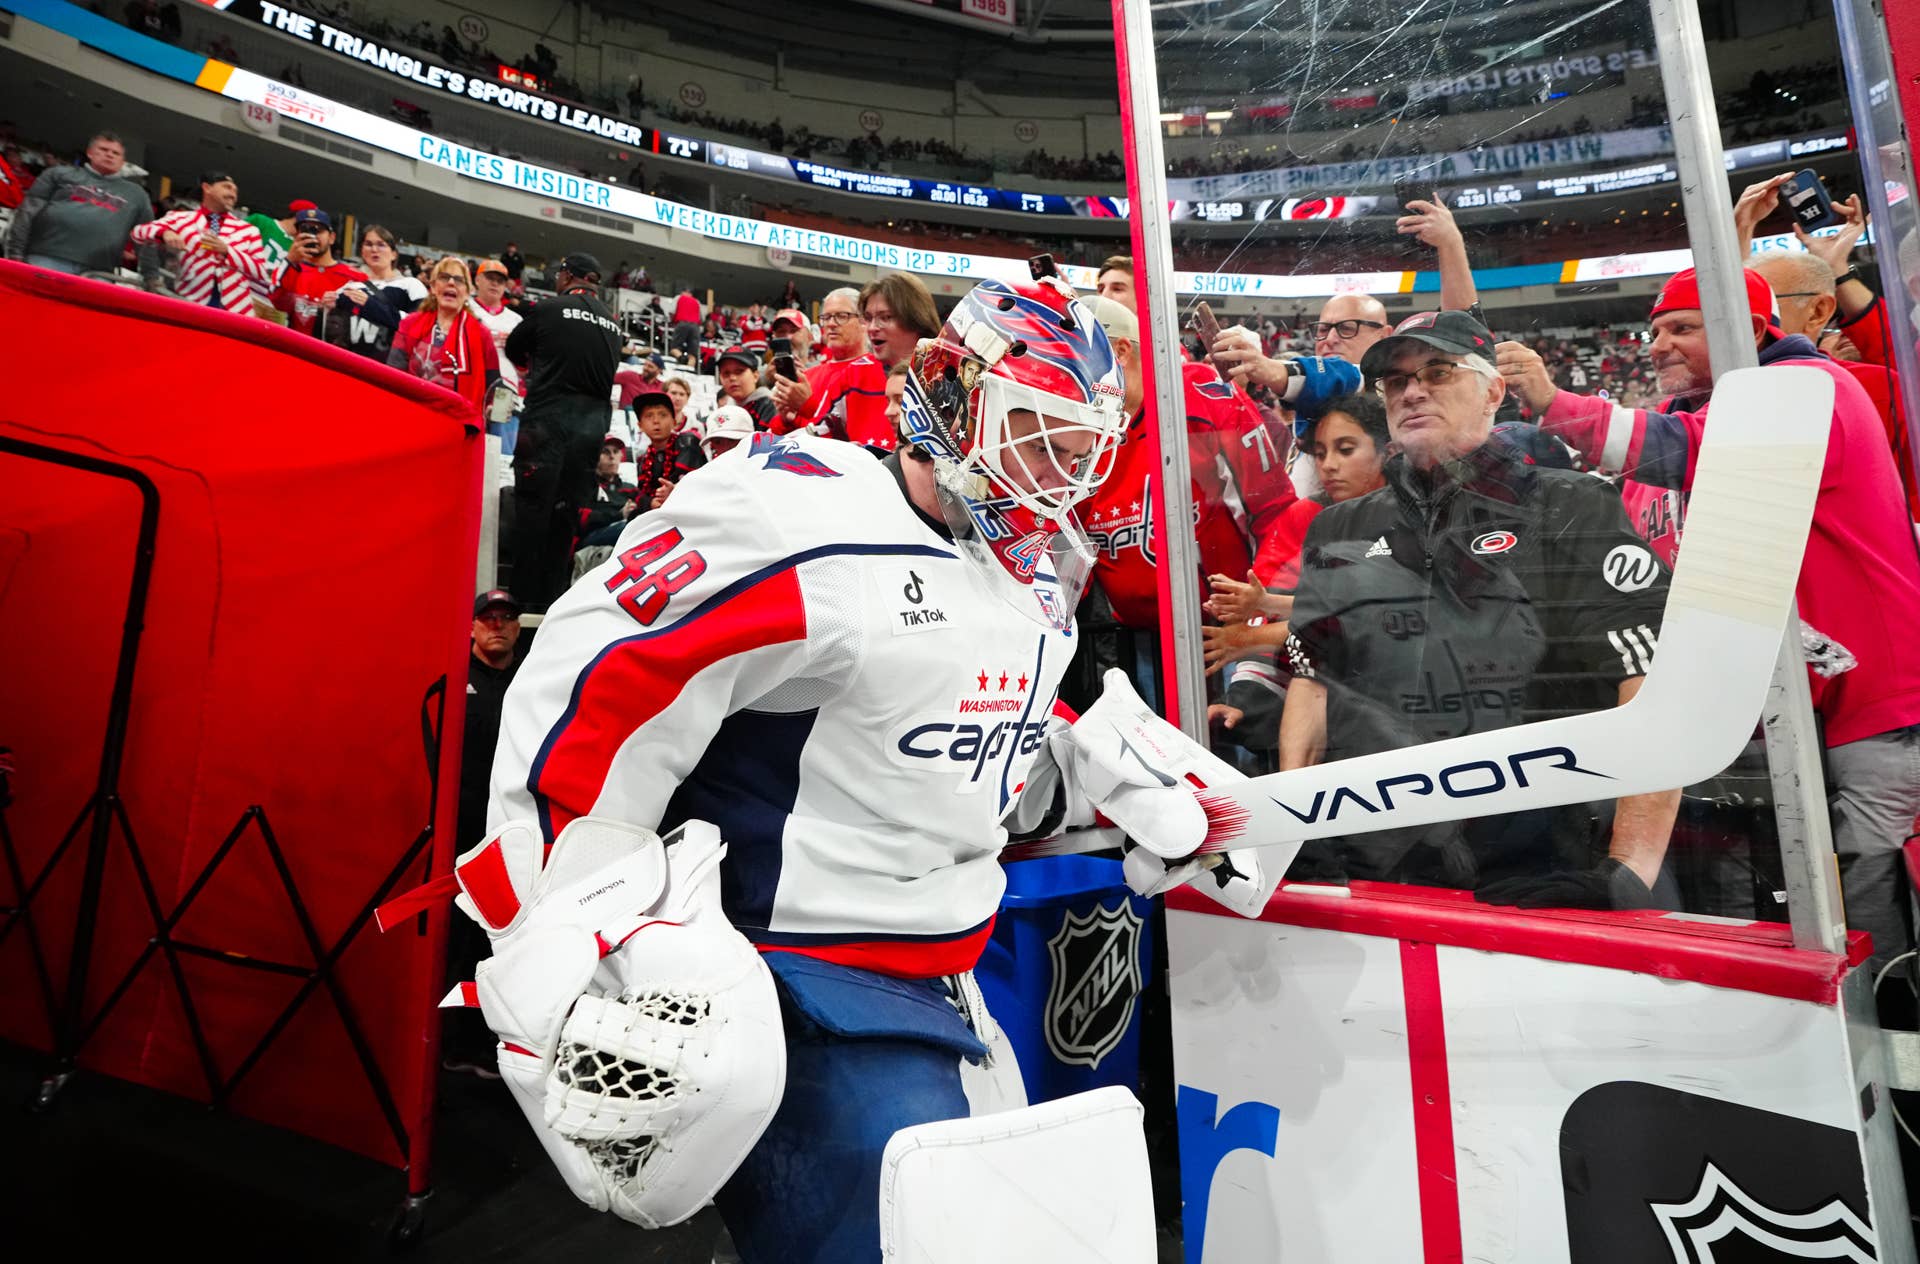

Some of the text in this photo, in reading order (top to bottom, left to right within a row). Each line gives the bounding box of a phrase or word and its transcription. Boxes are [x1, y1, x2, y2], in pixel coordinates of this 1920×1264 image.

[260, 0, 643, 146] THE TRIANGLE'S SPORTS LEADER
[267, 83, 297, 99] 99.9
[247, 105, 273, 124] 124
[264, 93, 326, 122] ESPN
[420, 137, 610, 207] CANES INSIDER
[655, 200, 759, 241] WEEKDAY
[768, 226, 898, 266] AFTERNOONS
[771, 249, 788, 260] 125
[1194, 275, 1248, 293] SHOW
[562, 308, 621, 336] SECURITY
[1089, 513, 1141, 530] WASHINGTON
[1364, 547, 1393, 558] adidas
[604, 526, 708, 627] 48
[900, 609, 948, 627] TikTok
[959, 700, 1023, 713] WASHINGTON
[1269, 746, 1621, 824] VAPOR
[578, 878, 625, 906] THOMPSON
[1070, 941, 1127, 1039] NHL
